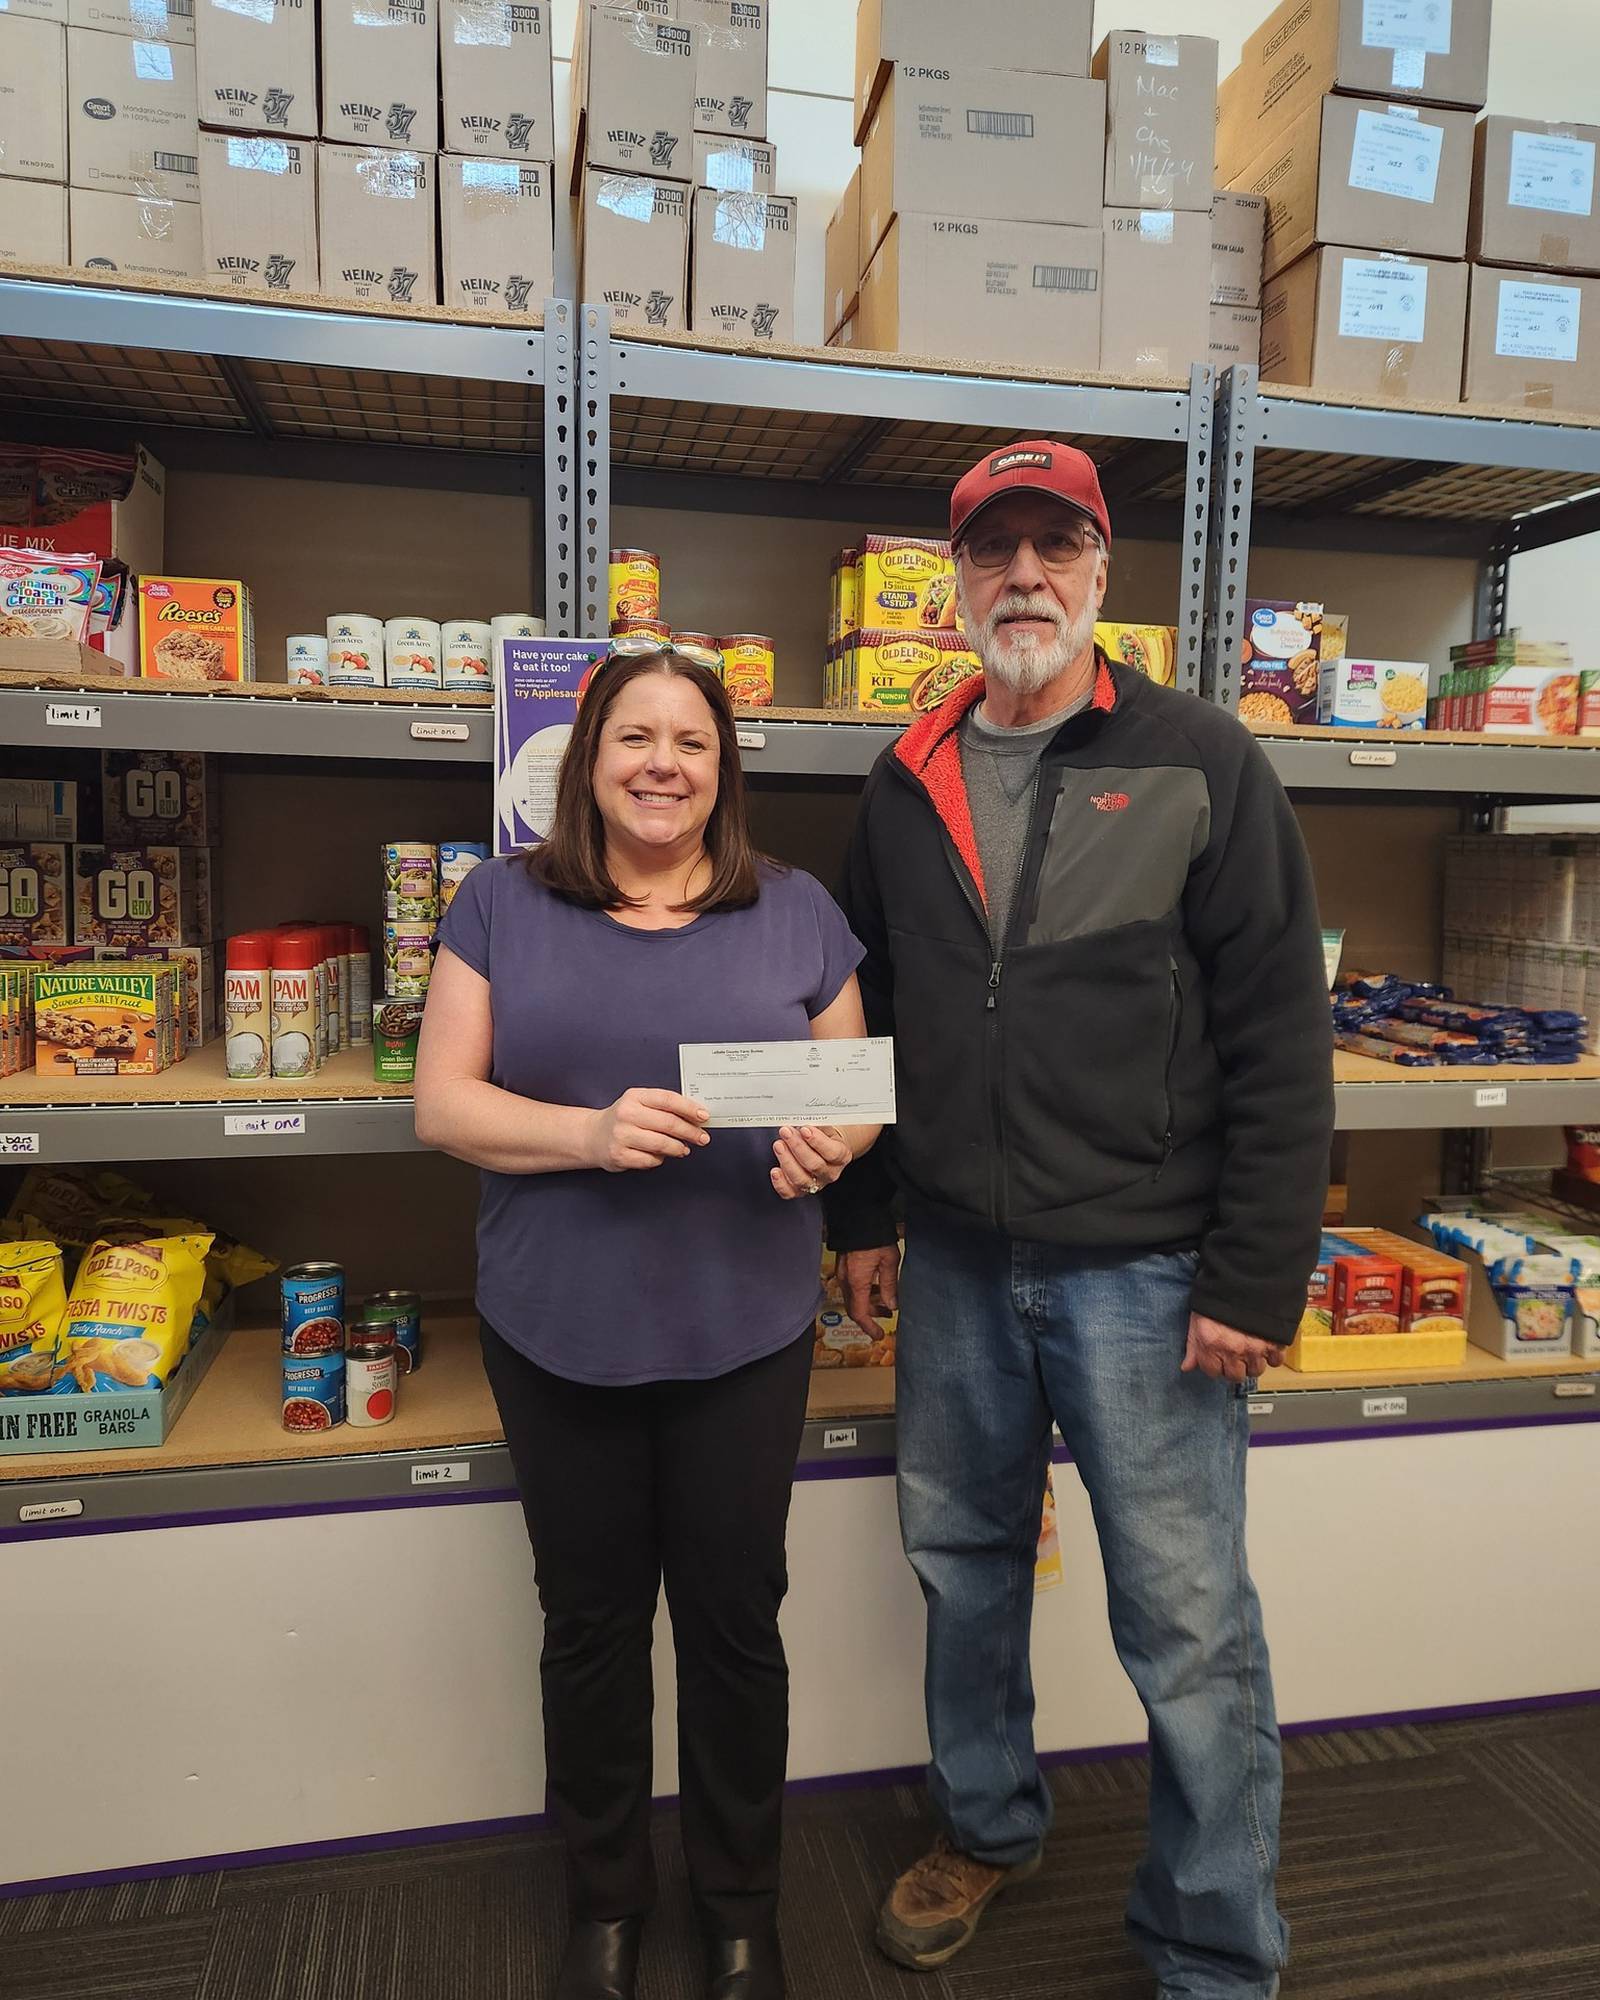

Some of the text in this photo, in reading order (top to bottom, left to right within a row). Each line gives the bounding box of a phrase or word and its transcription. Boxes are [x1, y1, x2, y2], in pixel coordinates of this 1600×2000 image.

[733, 4, 757, 15] 13000
[730, 15, 760, 29] 00110
[656, 39, 691, 56] 00110
[1119, 43, 1130, 54] 12
[903, 67, 951, 81] 12 PKGS
[1136, 75, 1179, 100] Mac
[214, 88, 258, 105] HEINZ
[86, 101, 111, 113] Great
[122, 104, 187, 120] Mandarin Oranges
[229, 107, 243, 117] HOT
[340, 103, 382, 120] HEINZ
[1143, 106, 1160, 117] +
[151, 116, 170, 125] Juice
[702, 113, 714, 122] HOT
[353, 122, 368, 133] HOT
[460, 116, 501, 132] HEINZ
[474, 134, 488, 144] HOT
[607, 130, 646, 147] HEINZ
[619, 150, 632, 159] HOT
[933, 222, 978, 234] 12 PKGS
[1112, 219, 1122, 231] 12
[217, 256, 260, 273] HEINZ
[231, 275, 246, 285] HOT
[342, 269, 384, 285] HEINZ
[355, 287, 370, 297] HOT
[460, 278, 500, 294] HEINZ
[473, 296, 487, 306] HOT
[603, 290, 642, 307] HEINZ
[615, 309, 628, 319] HOT
[710, 305, 748, 320] HEINZ
[722, 322, 735, 332] HOT
[998, 454, 1034, 466] CASE
[25, 537, 55, 551] MIX
[885, 553, 915, 567] OLD EL
[8, 580, 67, 593] Cinnamon
[883, 580, 893, 590] 15
[18, 587, 57, 598] Toast
[882, 592, 909, 600] STAND
[6, 596, 64, 607] Crunch
[889, 600, 914, 608] STUFF
[158, 601, 224, 624] Reese's
[396, 639, 432, 648] Green Acres
[512, 649, 589, 662] Have your cake
[881, 647, 912, 661] OLD EL
[513, 662, 571, 673] & eat it too!
[871, 676, 896, 687] KIT
[514, 689, 529, 699] try
[876, 692, 907, 700] CRUNCHY
[51, 709, 91, 721] limit 1
[441, 728, 456, 736] one
[126, 769, 181, 818] GO
[1090, 795, 1120, 806] NORTH
[98, 869, 155, 920] GO
[14, 897, 36, 914] BOX
[131, 900, 152, 916] BOX
[40, 977, 150, 999] NATURE VALLEY
[227, 980, 260, 1000] PAM
[273, 980, 307, 1000] PAM
[52, 994, 142, 1009] Sweet SALTY nut
[274, 1116, 301, 1130] one
[5, 1136, 33, 1145] bars
[12, 1143, 35, 1152] one
[106, 1255, 122, 1270] EL
[1366, 1278, 1385, 1287] BEEF
[298, 1286, 337, 1304] PROGRESSO
[67, 1299, 168, 1324] FIESTA TWISTS
[304, 1304, 334, 1315] BEEF BARLEY
[71, 1323, 122, 1335] Zesty Ranch
[284, 1369, 321, 1380] PROGRESSO
[297, 1385, 316, 1393] BARLEY
[371, 1378, 391, 1391] Soup
[1367, 1402, 1405, 1414] limit one
[27, 1408, 150, 1439] FREE GRANOLA
[99, 1421, 136, 1435] BARS
[829, 1433, 848, 1444] limit
[414, 1467, 453, 1481] limit 2
[23, 1505, 68, 1518] limit one
